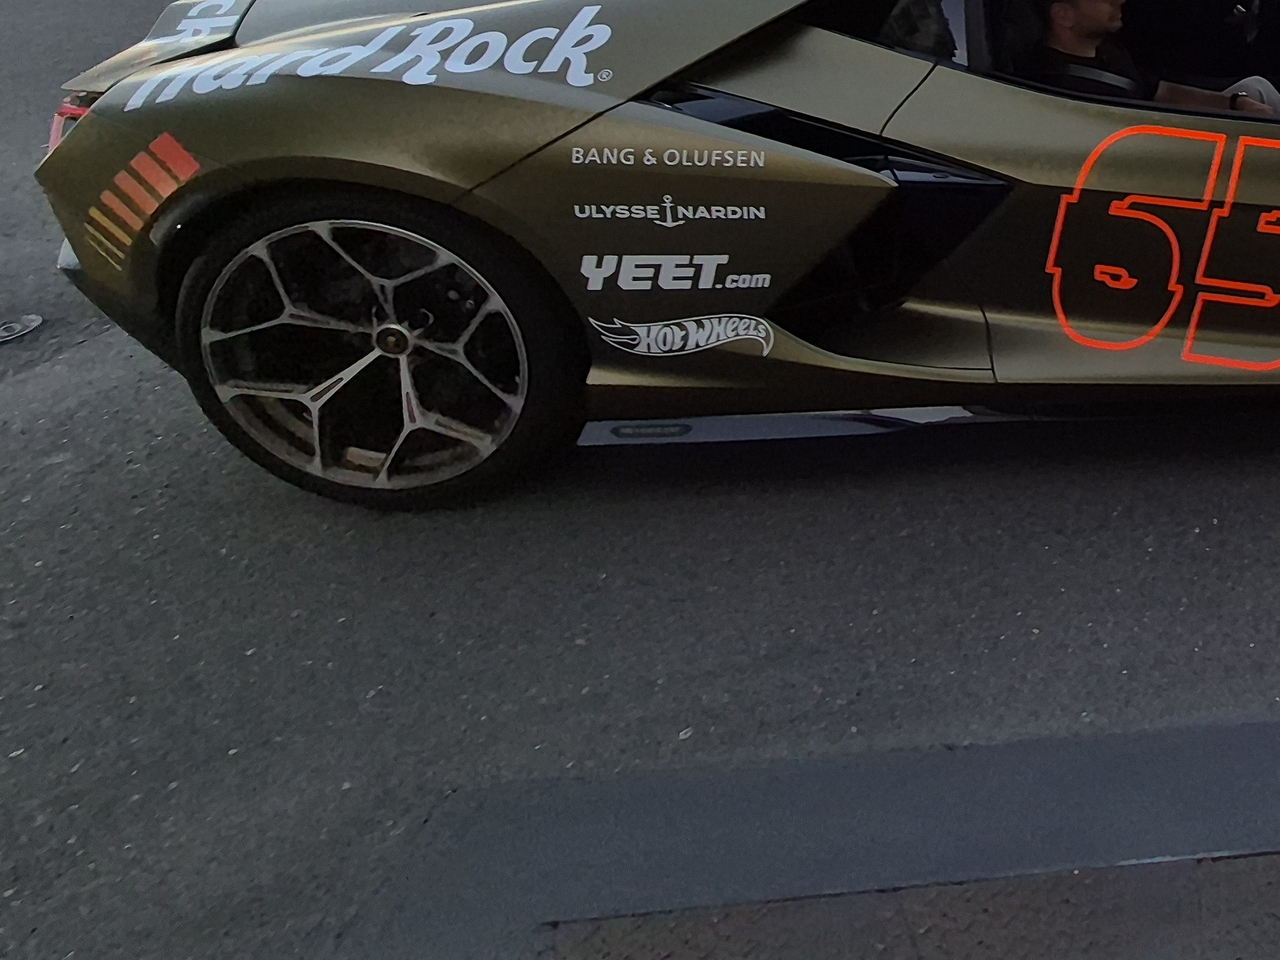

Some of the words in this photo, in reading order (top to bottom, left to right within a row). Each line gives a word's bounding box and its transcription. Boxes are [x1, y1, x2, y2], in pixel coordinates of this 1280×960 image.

[571, 147, 635, 166] BANG
[642, 148, 658, 166] &
[663, 149, 766, 168] OLUFSEN
[574, 204, 661, 219] ULYSSE
[677, 205, 766, 220] NARDIN
[580, 254, 772, 291] YEET.com
